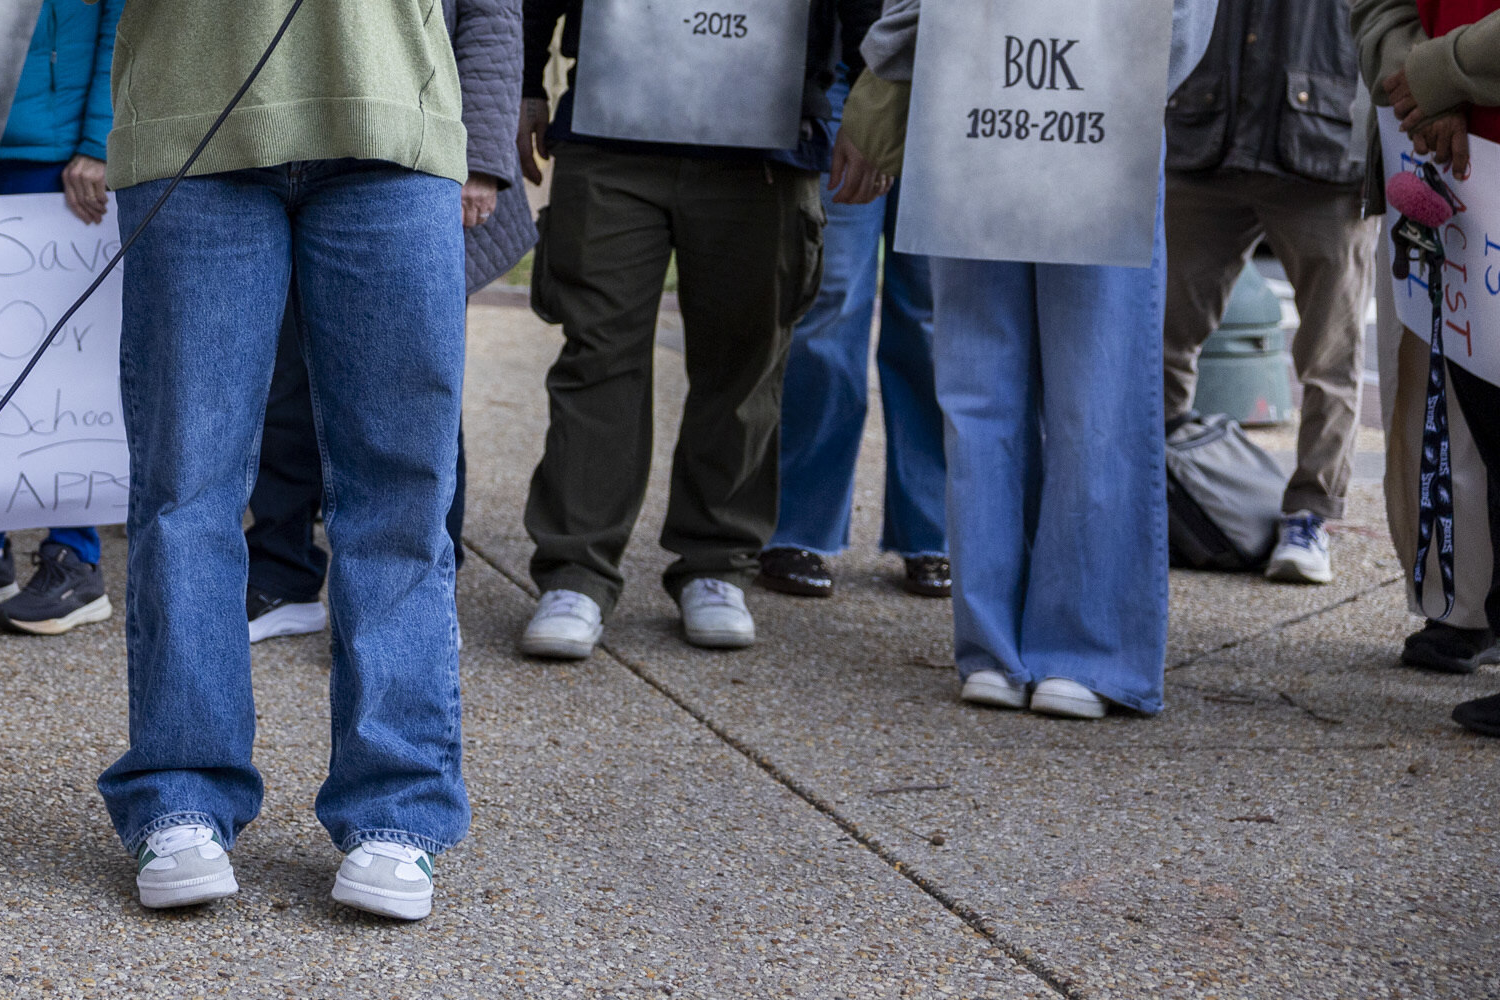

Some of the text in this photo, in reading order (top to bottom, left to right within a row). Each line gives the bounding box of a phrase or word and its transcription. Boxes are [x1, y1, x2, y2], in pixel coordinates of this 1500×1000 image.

[683, 11, 749, 39] -2013
[1003, 34, 1085, 92] BOK
[965, 107, 1106, 145] 1938-2013
